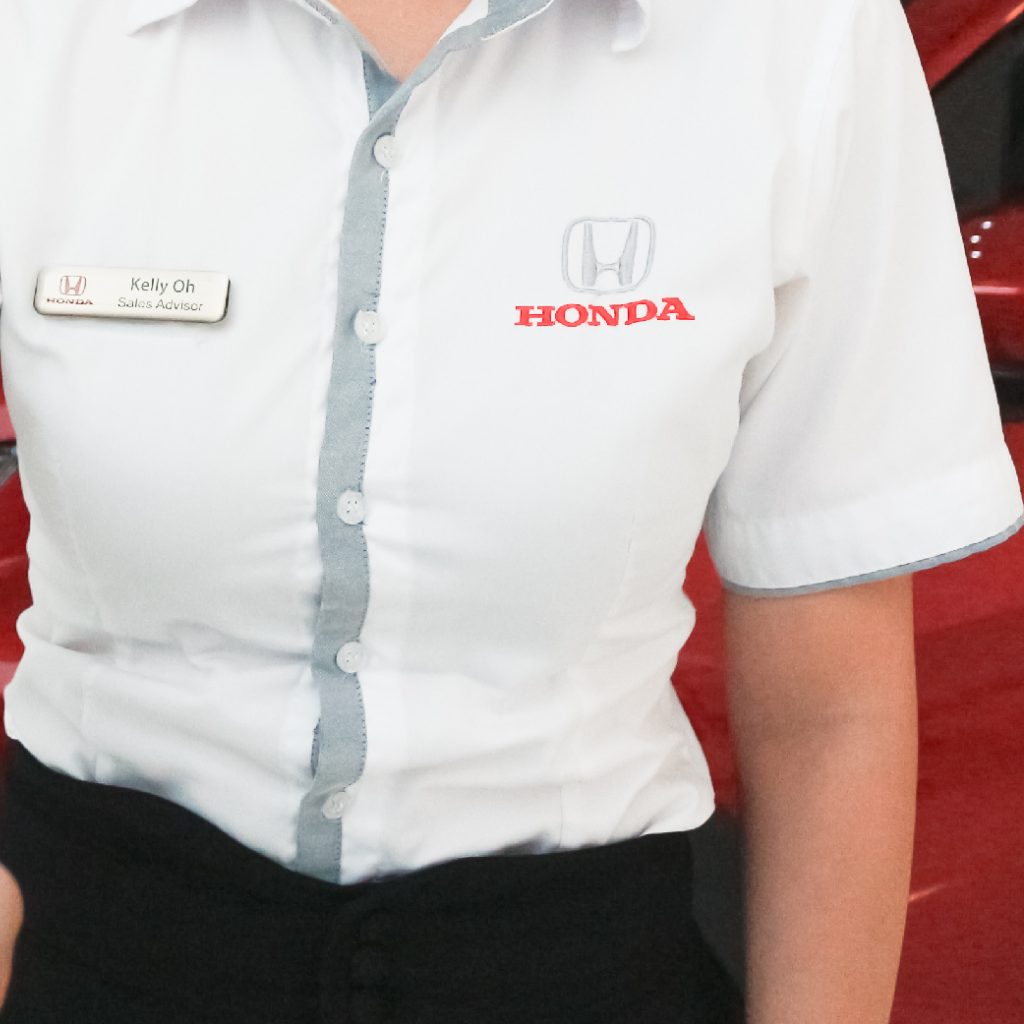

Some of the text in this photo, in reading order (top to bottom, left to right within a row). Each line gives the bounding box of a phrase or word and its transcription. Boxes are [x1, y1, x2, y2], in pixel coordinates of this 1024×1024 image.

[130, 277, 195, 296] Kelly Oh
[46, 297, 93, 305] HONDA
[117, 296, 203, 311] Sales Advisor
[513, 296, 696, 328] HONDA
